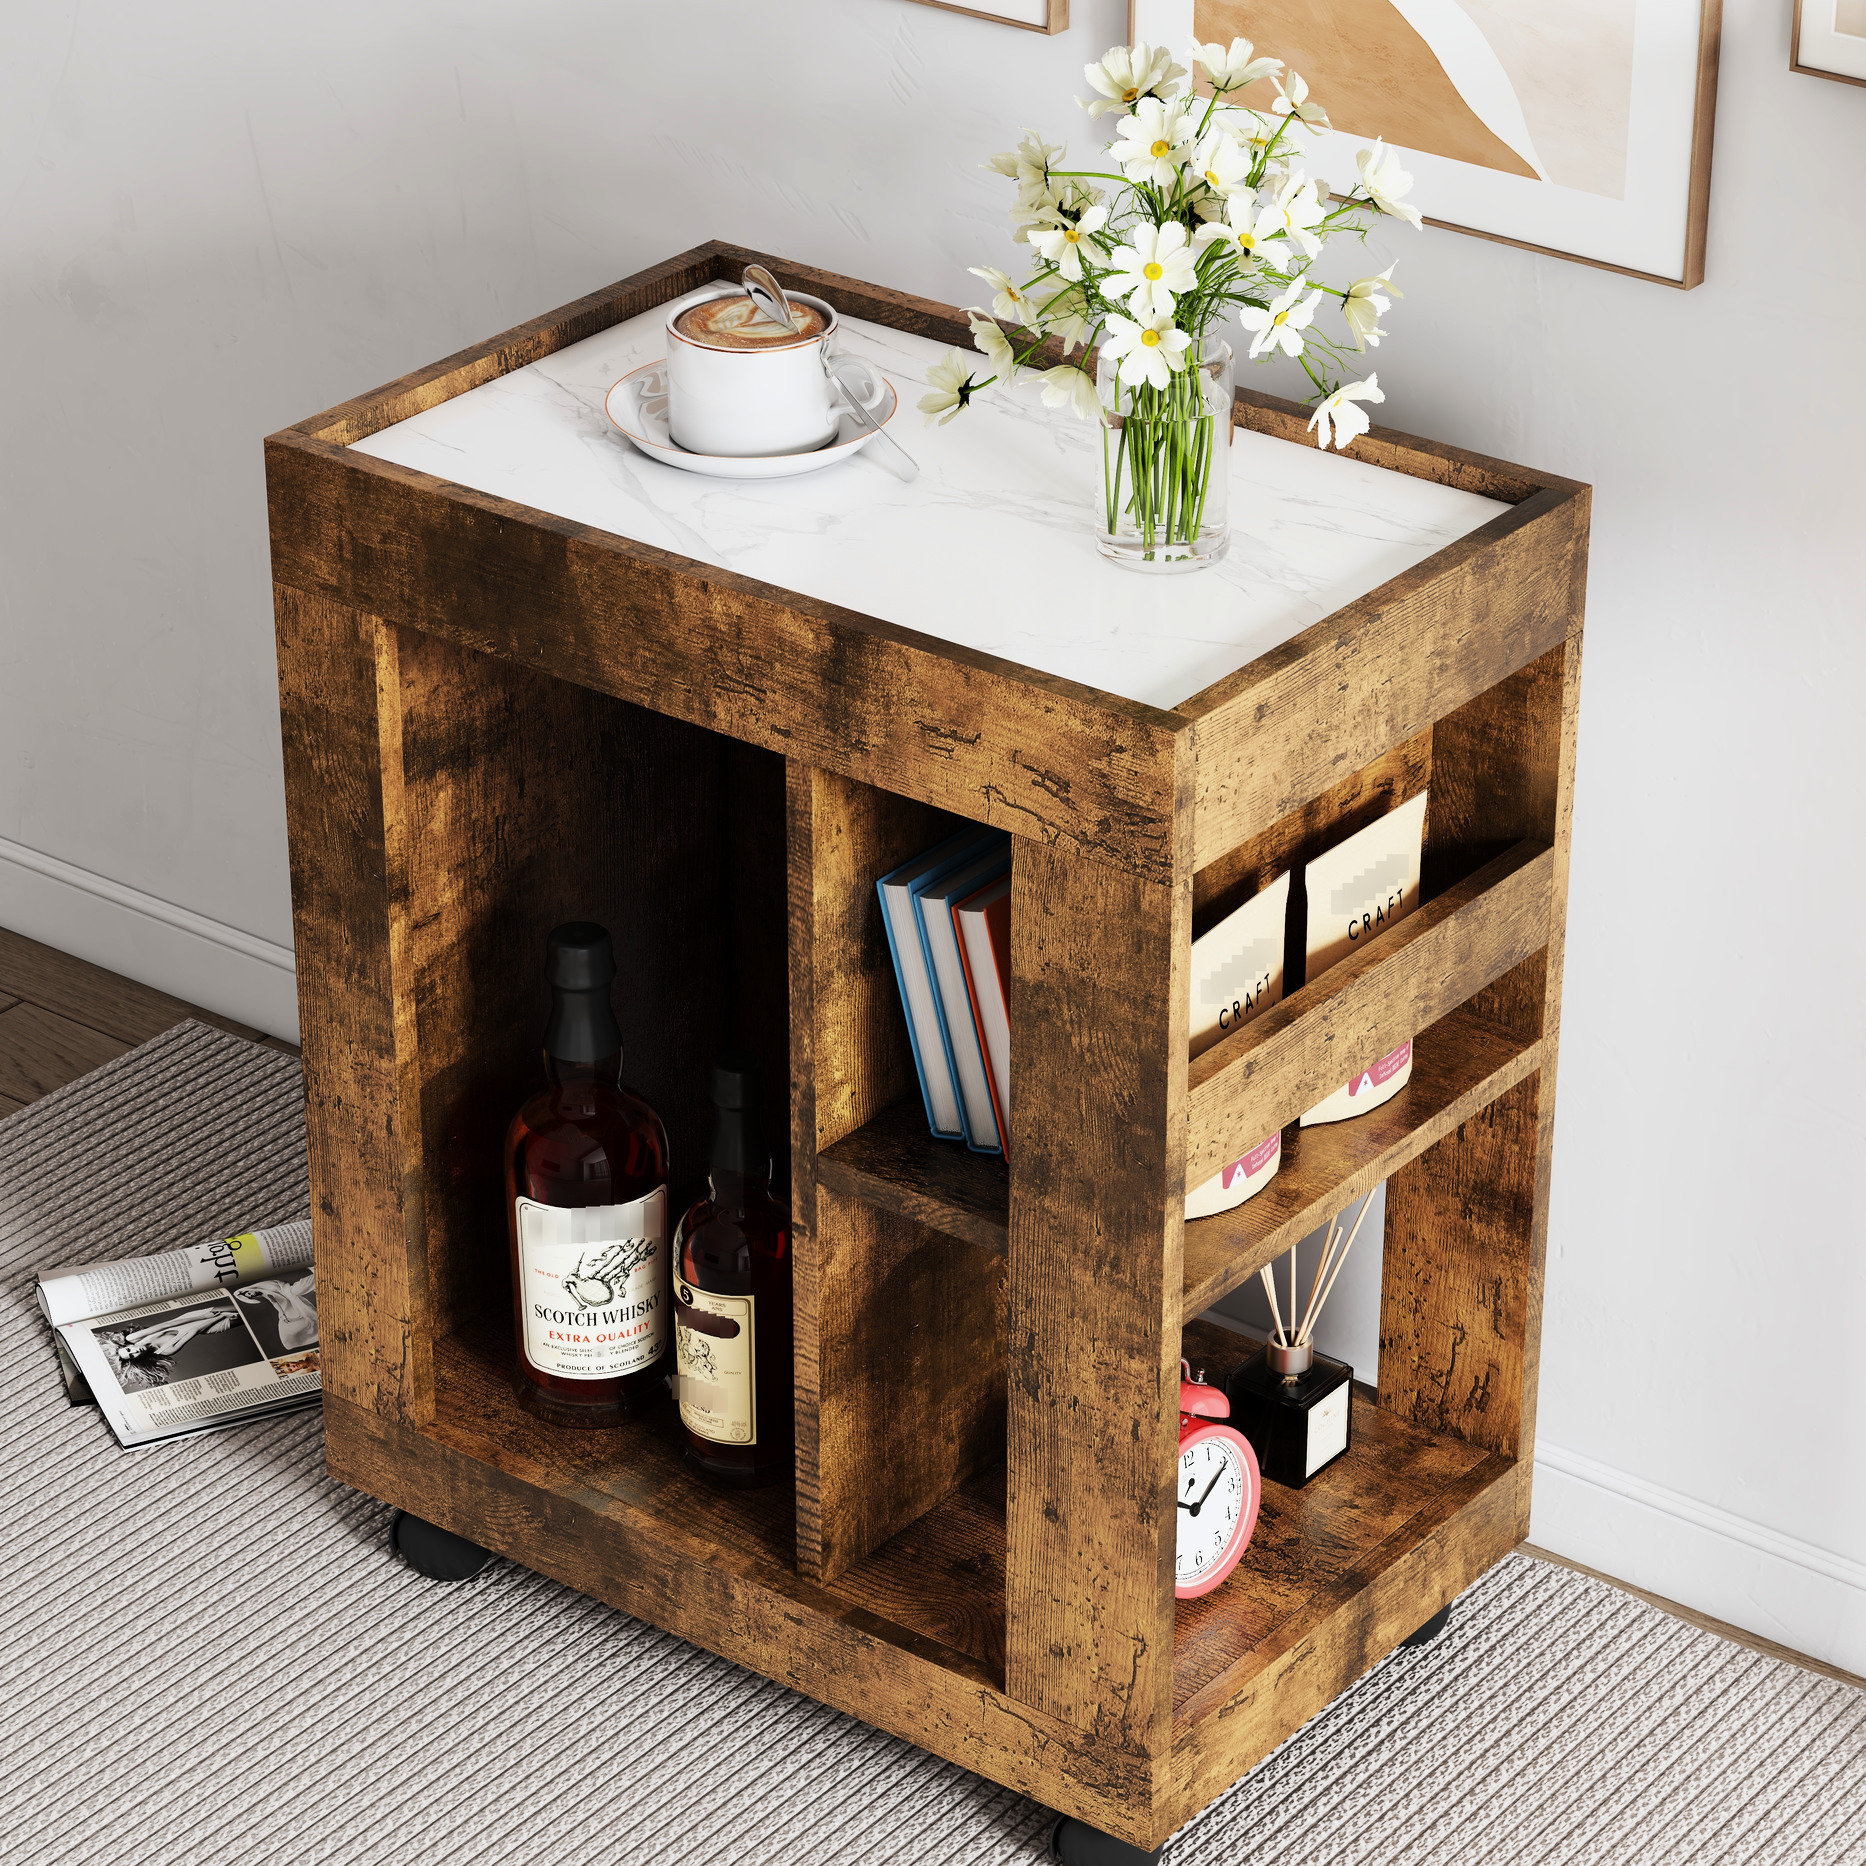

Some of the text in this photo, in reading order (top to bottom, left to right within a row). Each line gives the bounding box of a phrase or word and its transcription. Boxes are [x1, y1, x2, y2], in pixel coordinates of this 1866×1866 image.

[1348, 888, 1403, 941] CRAFT
[1218, 973, 1270, 1029] CRAFT
[683, 1288, 690, 1301] 5
[534, 1290, 661, 1327] SCOTCH WHISKY
[549, 1320, 651, 1343] EXTRA QUALITY
[551, 1344, 578, 1352] EXCLUSIVE
[618, 1340, 636, 1349] CHOICE
[637, 1331, 655, 1343] SCOTCH
[615, 1344, 640, 1355] BLENDED
[556, 1363, 591, 1371] PRODUCE
[609, 1354, 645, 1369] SCOTLAND
[1183, 1450, 1195, 1469] 12
[1206, 1447, 1211, 1461] 1
[1227, 1478, 1235, 1493] 3
[1225, 1505, 1232, 1520] 4
[1214, 1530, 1222, 1546] 5
[1195, 1550, 1203, 1566] 6
